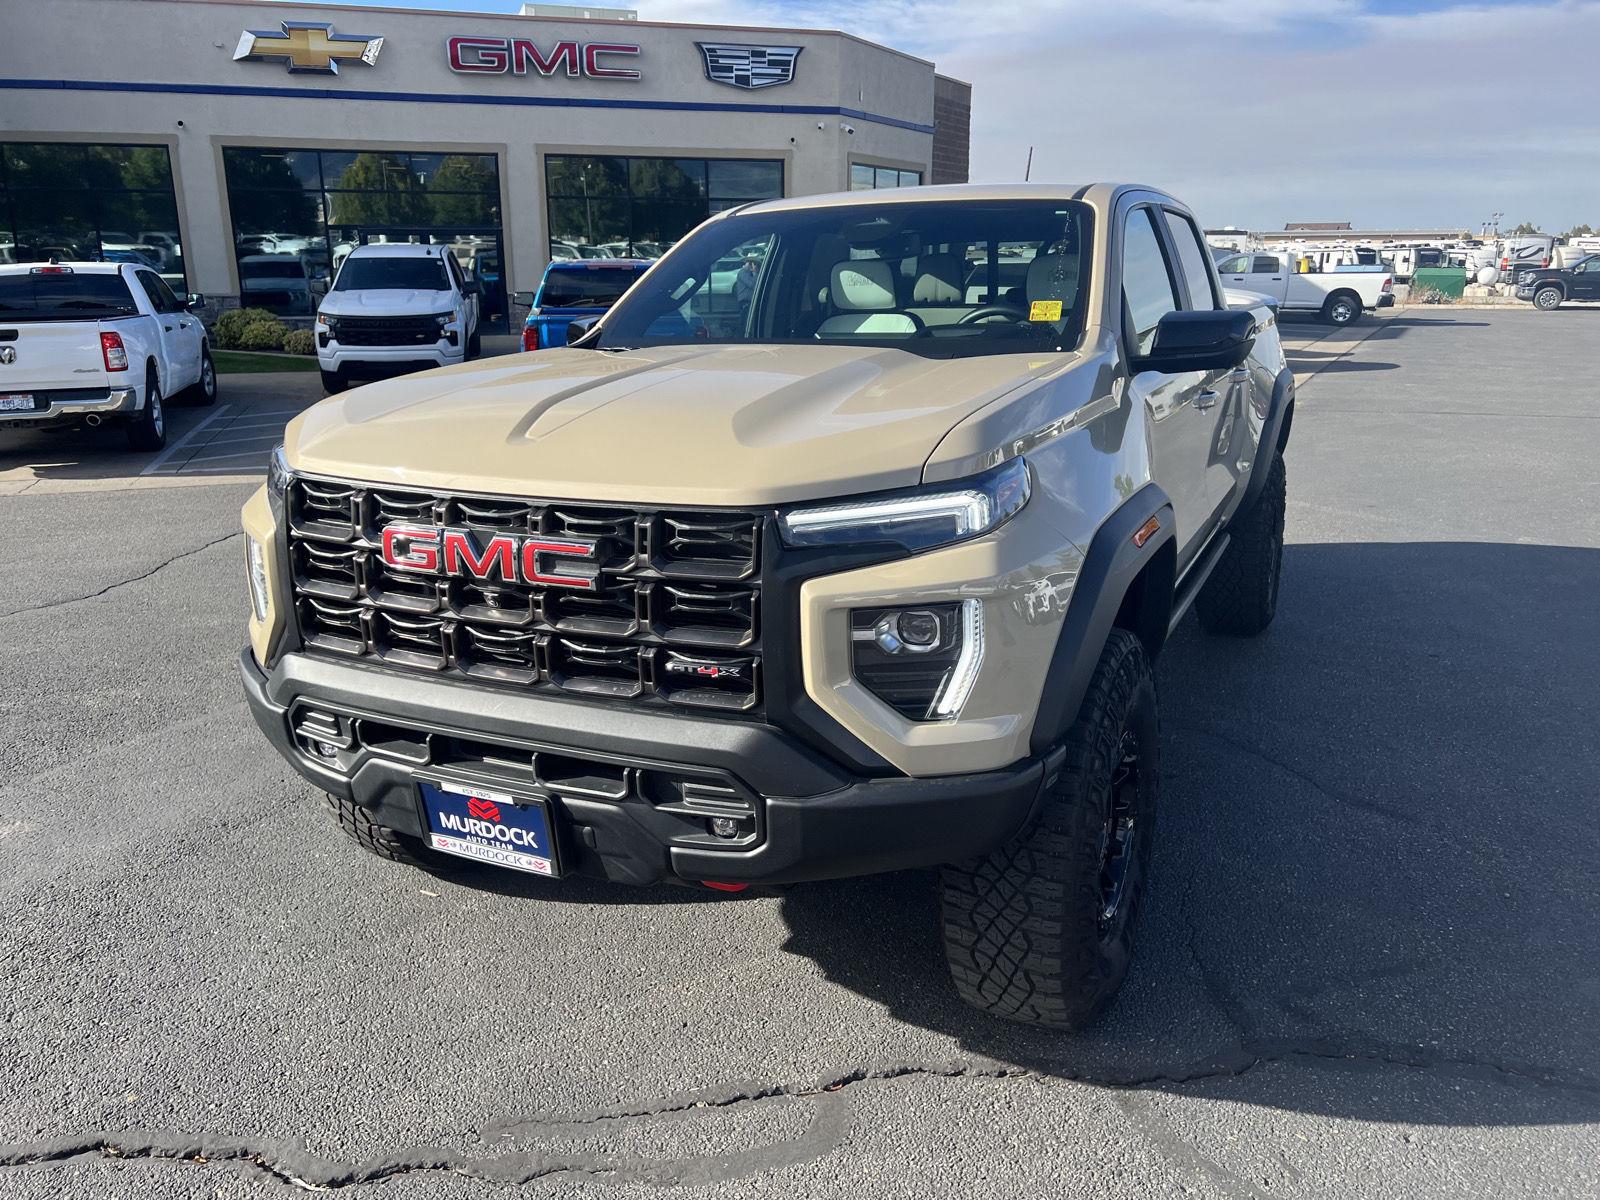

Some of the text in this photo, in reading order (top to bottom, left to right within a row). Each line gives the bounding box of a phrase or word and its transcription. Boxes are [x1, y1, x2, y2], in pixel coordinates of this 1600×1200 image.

[447, 36, 641, 80] GMC
[382, 525, 597, 590] GMC
[439, 811, 538, 849] MURDOCK
[466, 834, 513, 851] AUTO TEAM
[459, 843, 523, 866] MURDOCK
